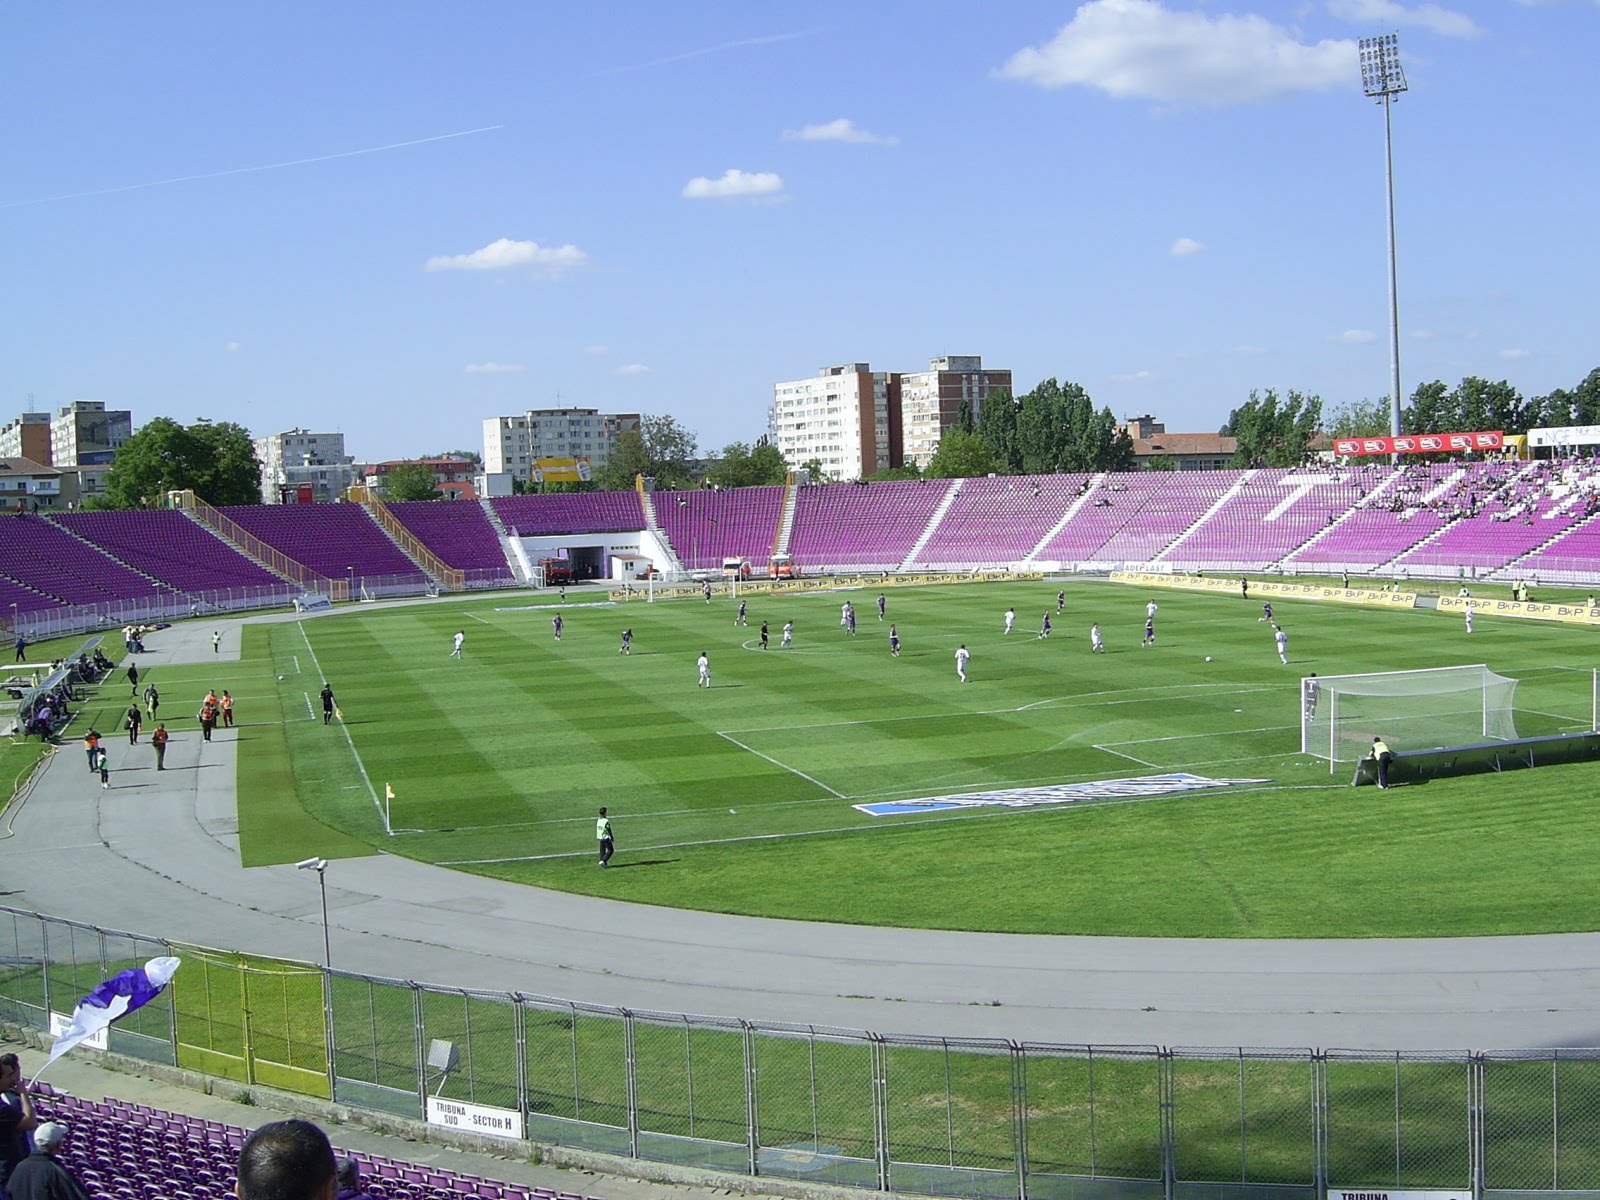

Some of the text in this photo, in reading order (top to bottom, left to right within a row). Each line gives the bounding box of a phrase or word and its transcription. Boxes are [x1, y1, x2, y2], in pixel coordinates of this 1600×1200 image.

[436, 1102, 466, 1116] TRIBUNA
[444, 1114, 458, 1125] SUD
[472, 1114, 503, 1129] SECTOR
[505, 1117, 512, 1130] H
